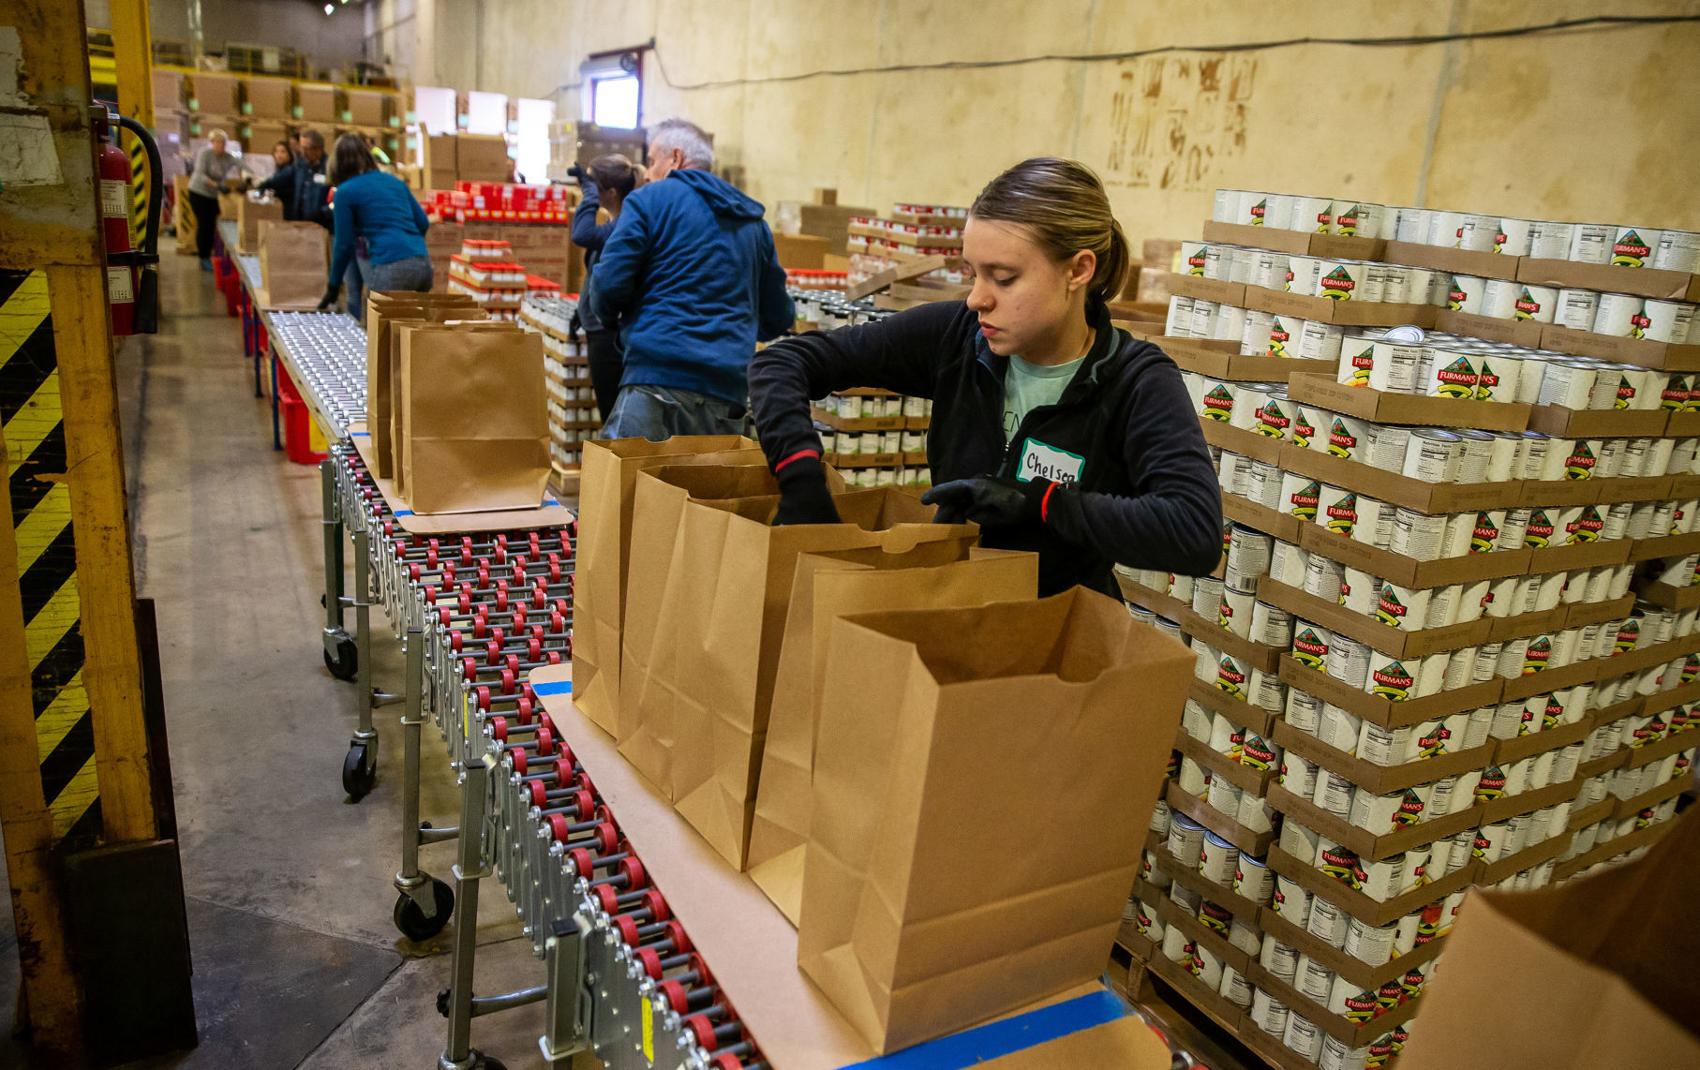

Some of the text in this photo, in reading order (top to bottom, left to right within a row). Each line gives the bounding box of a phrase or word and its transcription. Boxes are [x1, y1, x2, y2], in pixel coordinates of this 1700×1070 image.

[1323, 278, 1353, 289] FURMAN'S
[1440, 371, 1476, 384] FURMAN'S
[1293, 496, 1317, 504] FURMA
[1329, 508, 1354, 518] FURMA
[1375, 672, 1411, 687] FURMAN'S
[1347, 1000, 1376, 1009] FURMAN
